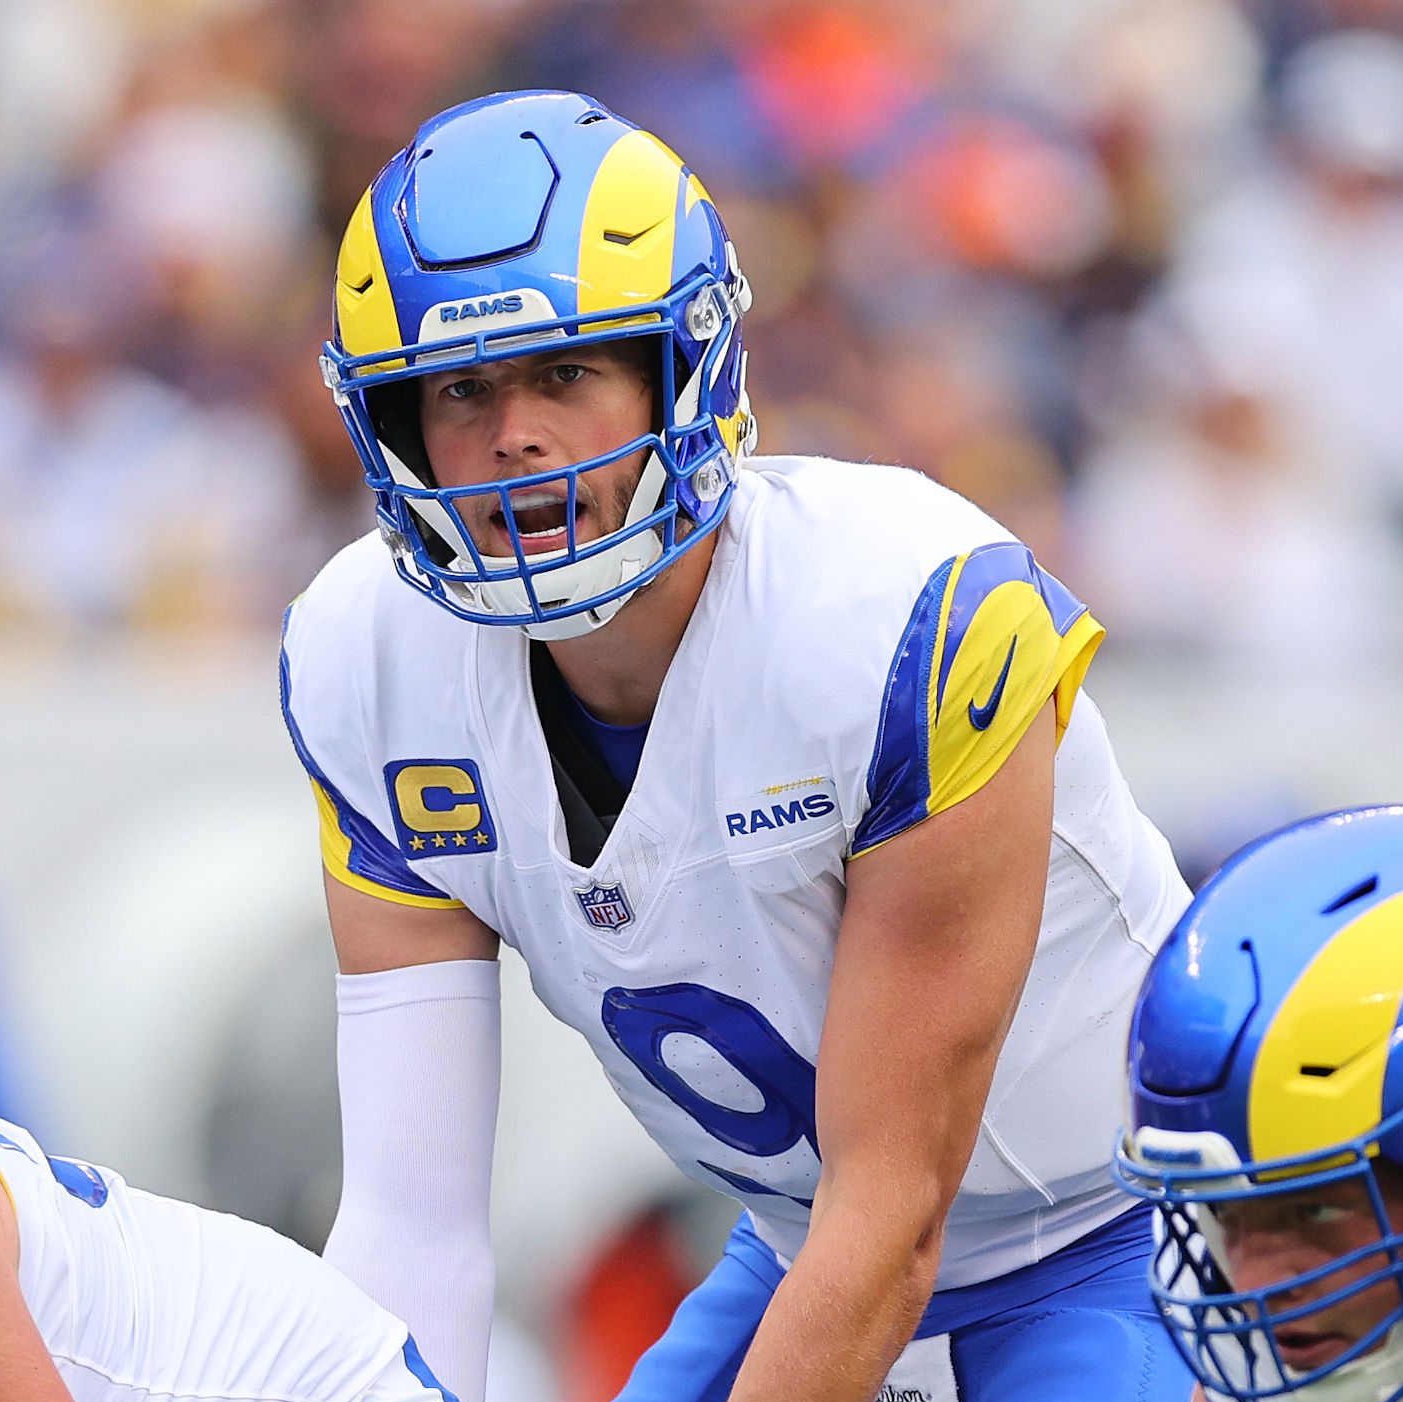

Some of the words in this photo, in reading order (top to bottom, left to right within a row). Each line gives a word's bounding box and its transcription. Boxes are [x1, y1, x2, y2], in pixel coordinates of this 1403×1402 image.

[440, 295, 523, 323] RAMS
[725, 794, 835, 837] RAMS
[588, 904, 628, 925] NFL
